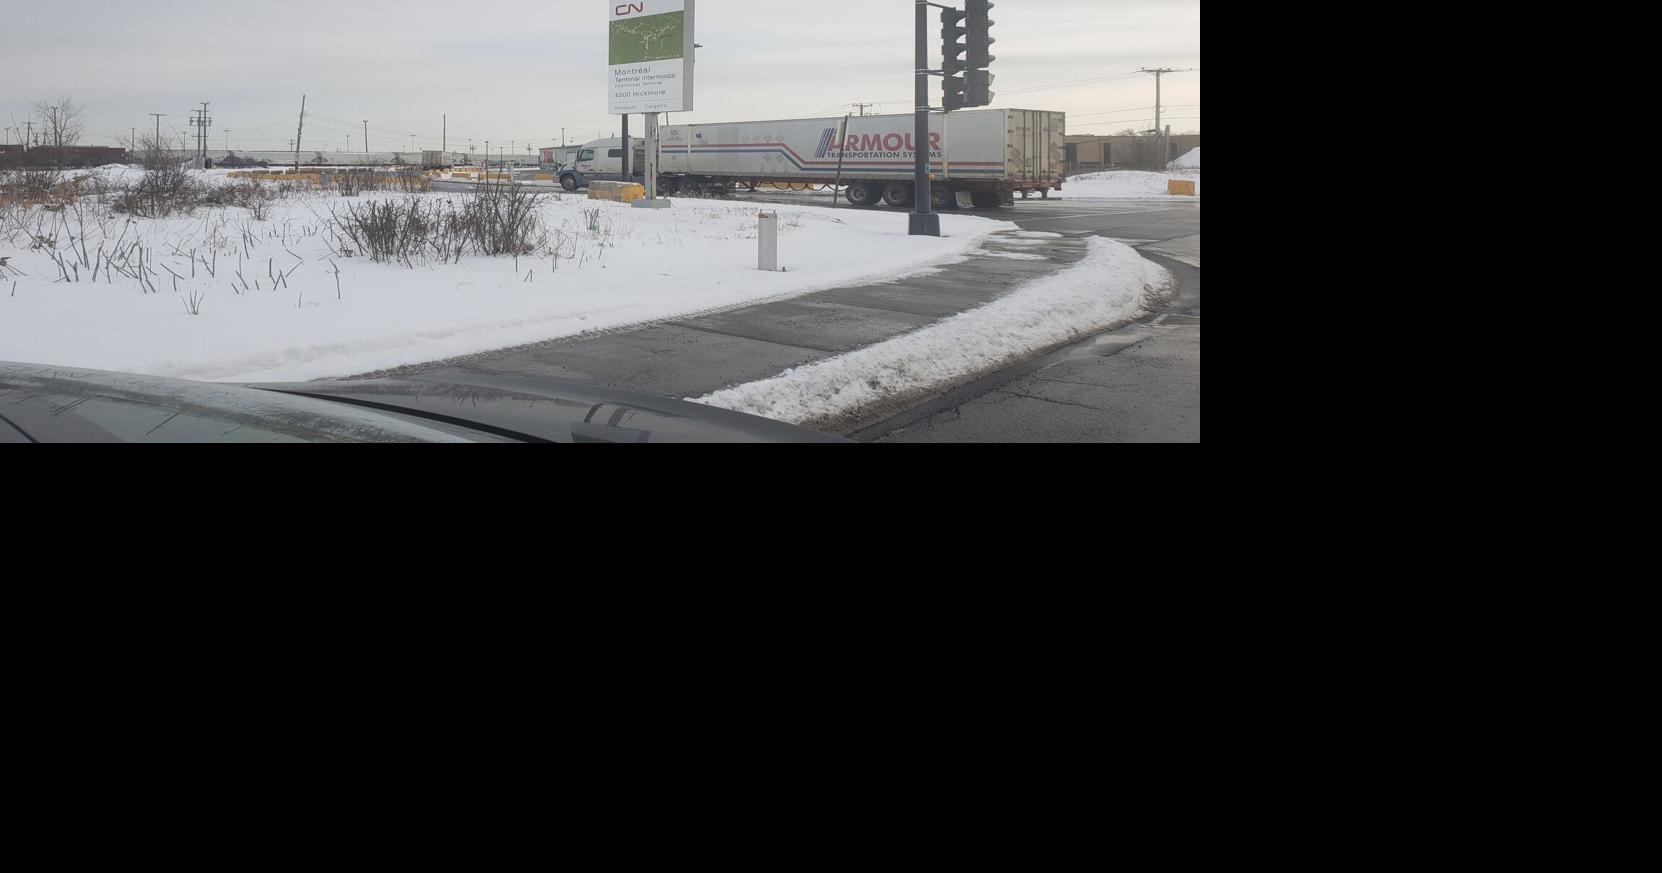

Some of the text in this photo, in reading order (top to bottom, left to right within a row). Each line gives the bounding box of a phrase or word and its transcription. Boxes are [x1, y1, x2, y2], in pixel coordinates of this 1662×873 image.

[615, 2, 643, 16] CN
[614, 66, 651, 76] Montréal
[827, 132, 941, 151] ARMOUR
